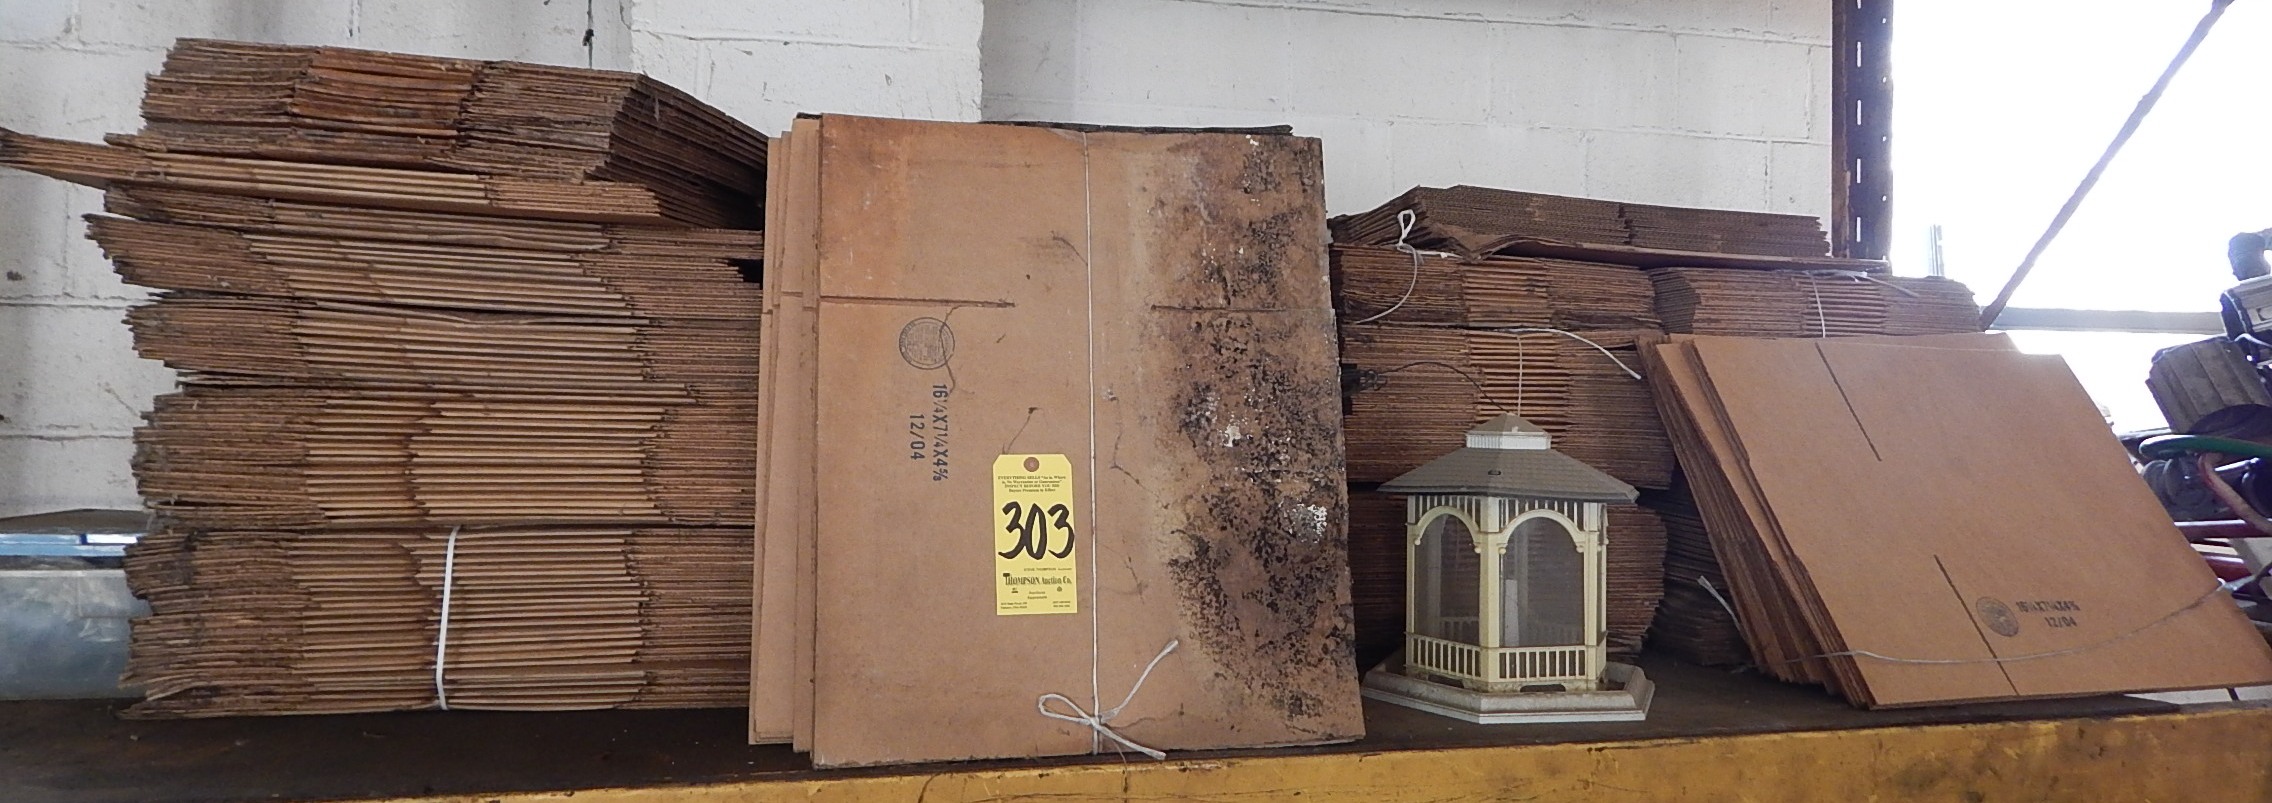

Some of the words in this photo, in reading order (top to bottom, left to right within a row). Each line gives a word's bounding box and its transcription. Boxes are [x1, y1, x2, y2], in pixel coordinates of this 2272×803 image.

[910, 414, 925, 460] 12/04
[998, 501, 1075, 560] 303
[1003, 573, 1040, 586] THOMPSON
[1041, 576, 1062, 585] Auction
[2044, 616, 2078, 628] 12/04
